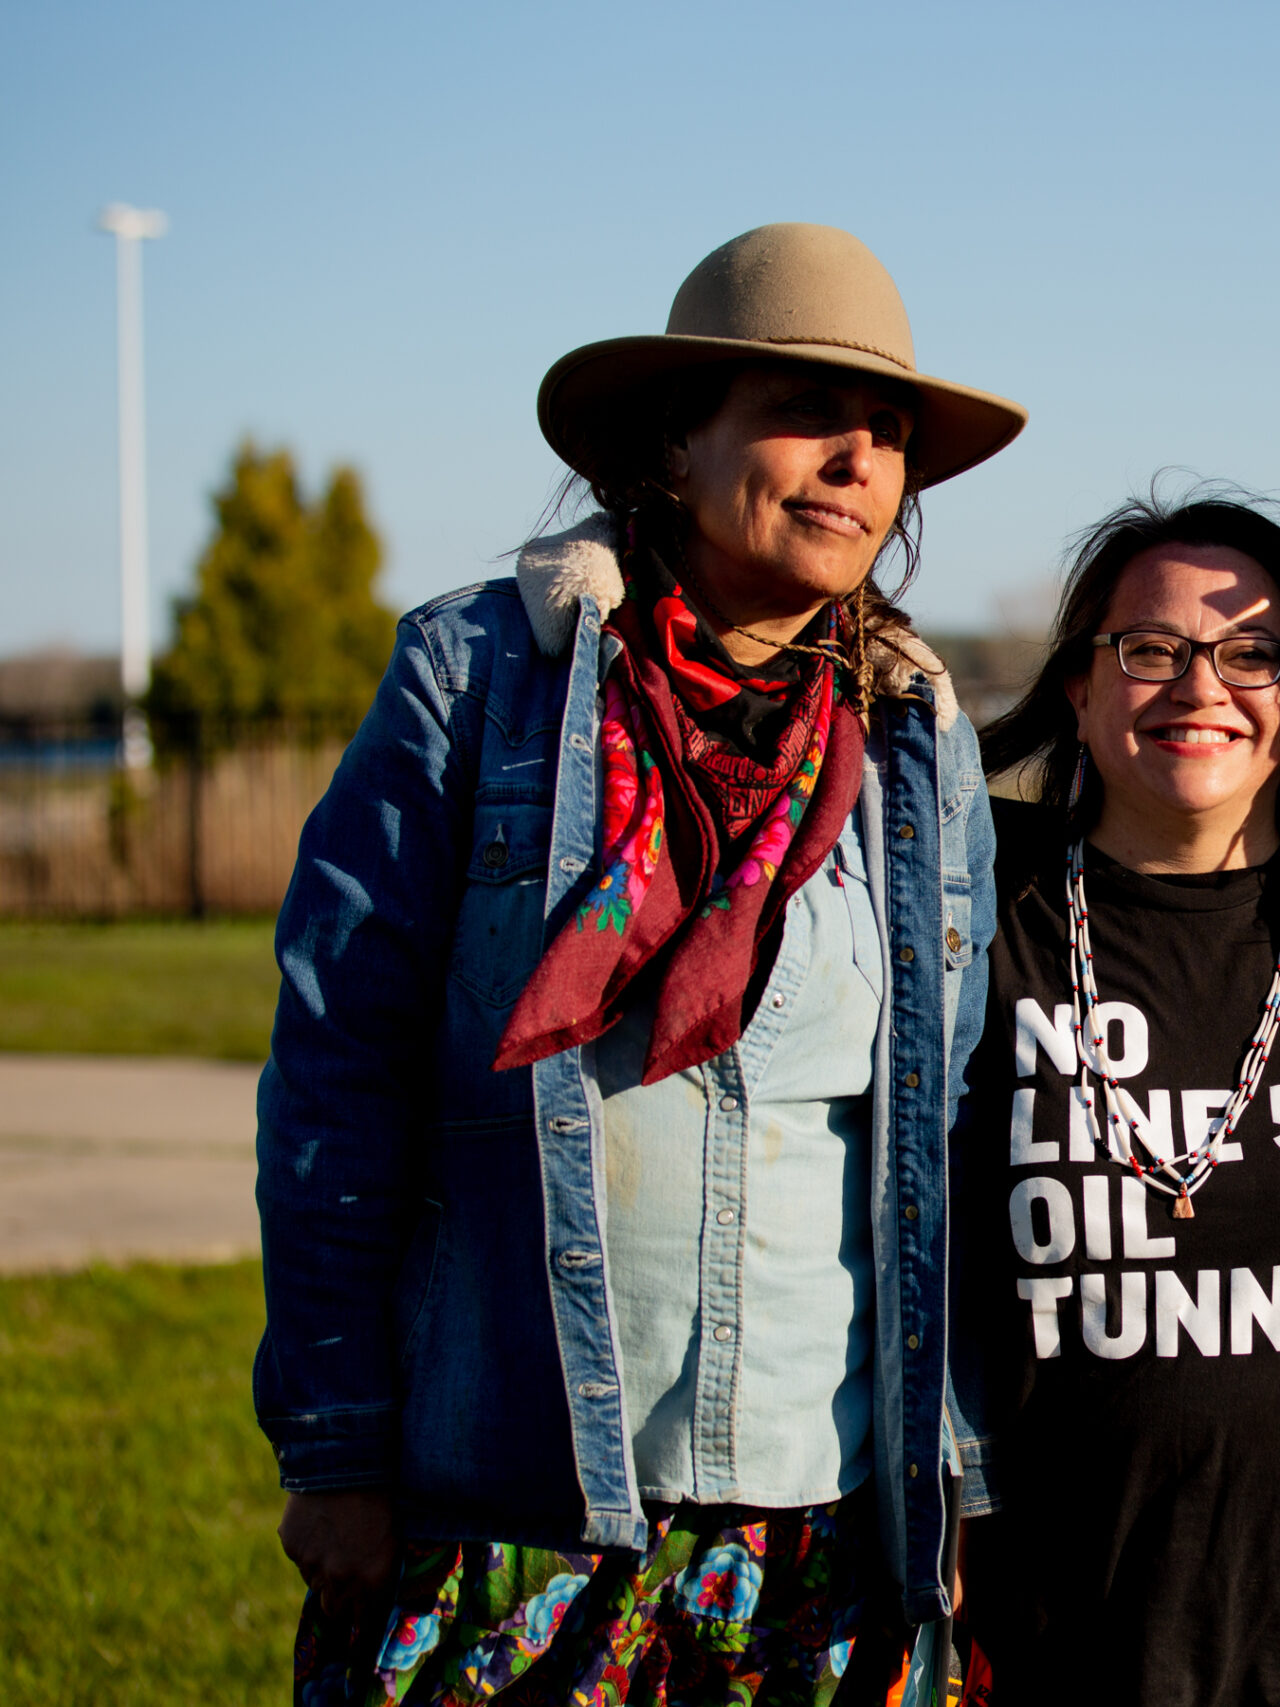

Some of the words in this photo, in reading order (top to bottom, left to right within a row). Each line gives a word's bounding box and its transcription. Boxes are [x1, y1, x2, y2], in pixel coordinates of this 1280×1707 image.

[1015, 998, 1149, 1078] NO
[1010, 1086, 1244, 1165] LINE
[1009, 1175, 1176, 1265] OIL
